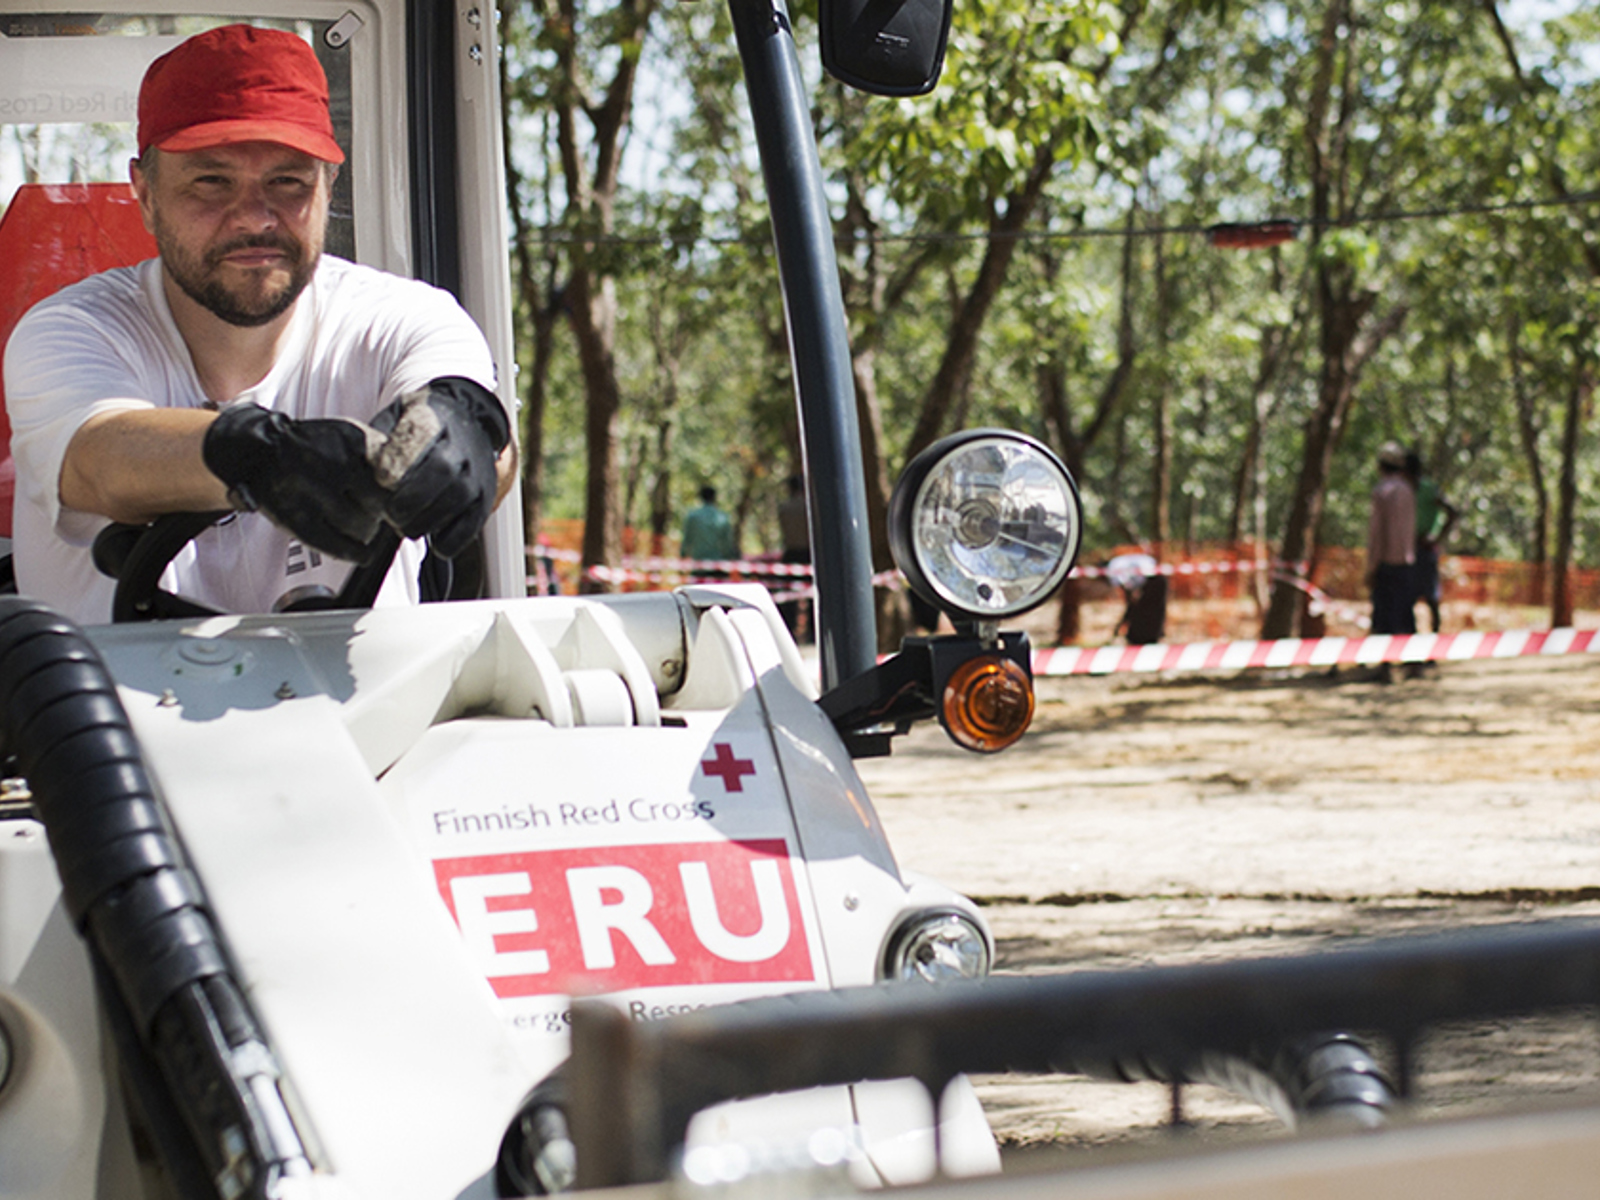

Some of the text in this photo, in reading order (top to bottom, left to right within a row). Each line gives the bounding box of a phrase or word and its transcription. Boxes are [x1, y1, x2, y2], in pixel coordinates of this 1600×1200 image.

[433, 798, 715, 834] Finnish Red Cross
[449, 858, 792, 977] ERU
